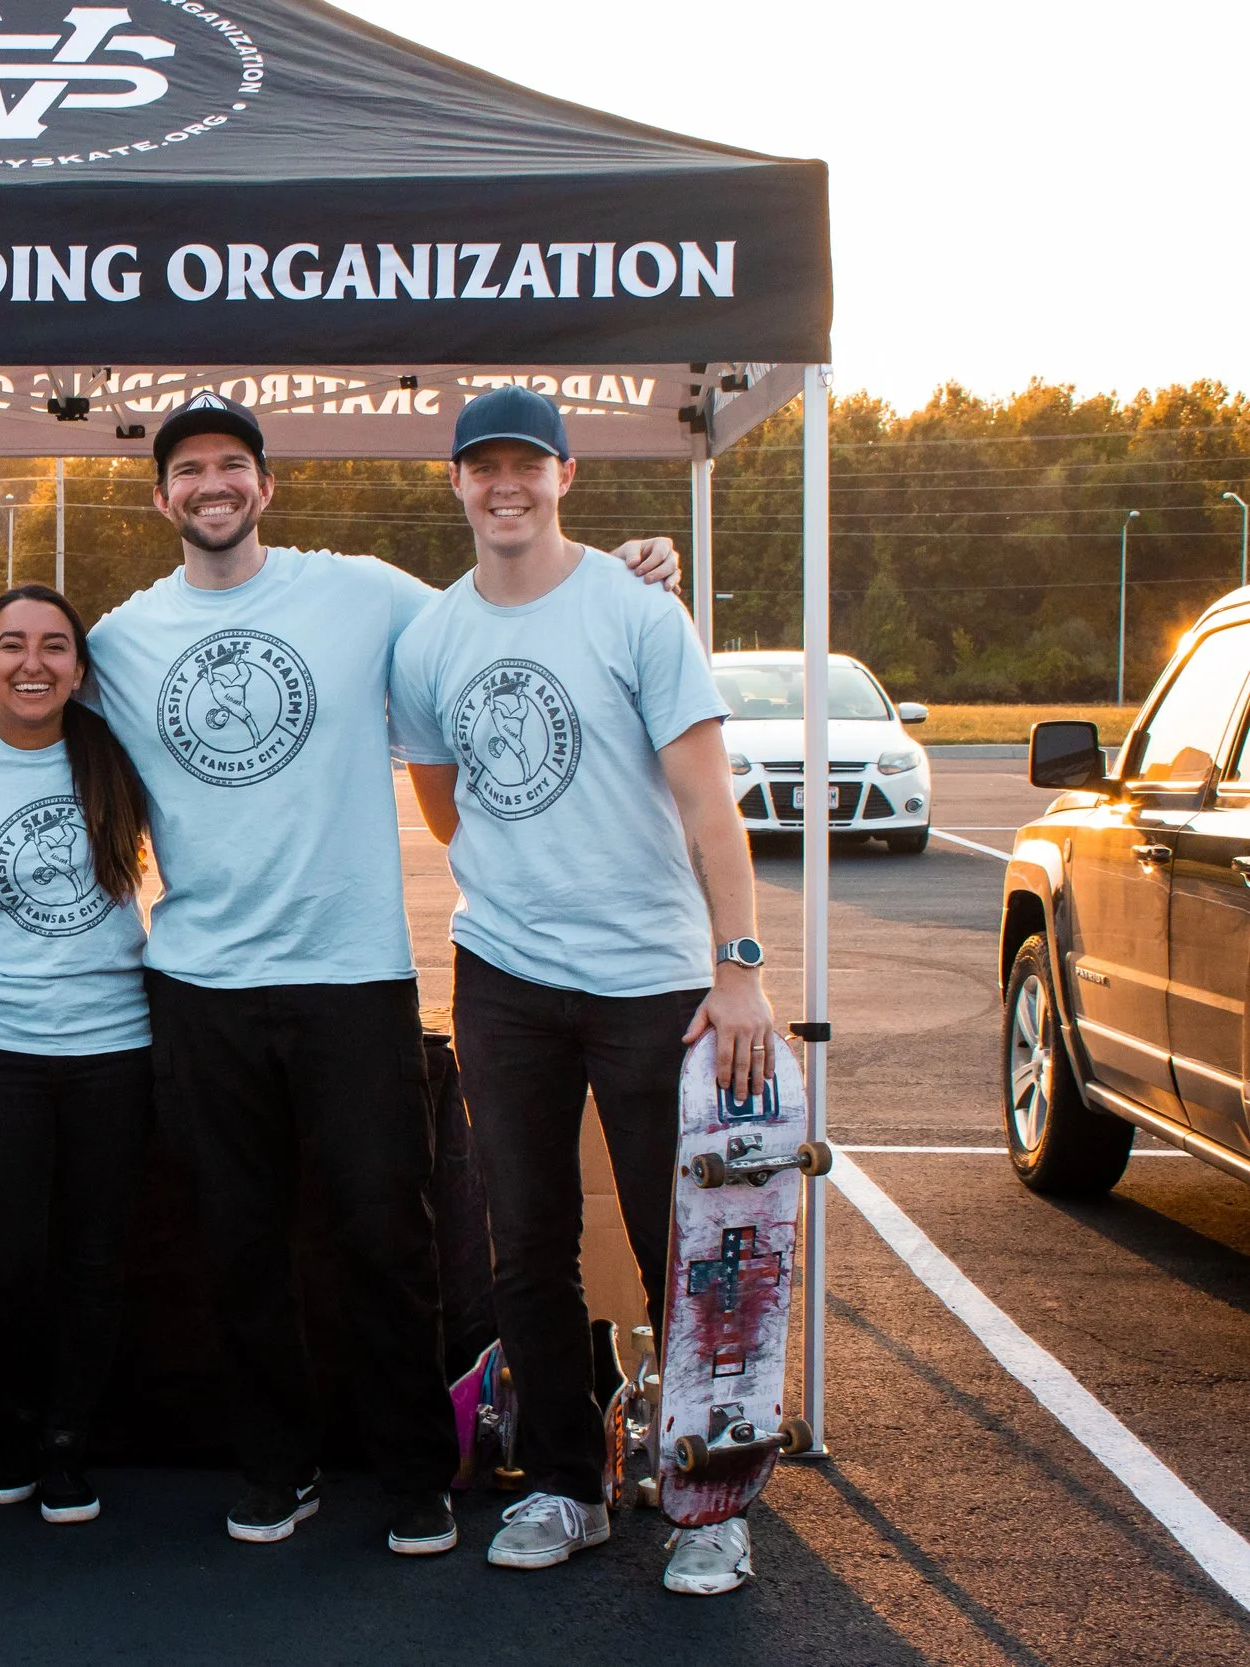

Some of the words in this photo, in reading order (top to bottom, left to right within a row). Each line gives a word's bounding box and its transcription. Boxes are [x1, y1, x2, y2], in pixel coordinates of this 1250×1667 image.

[161, 0, 265, 94] GANIZATION
[166, 239, 737, 302] ORGANIZATION
[168, 672, 193, 753] VARSITY
[194, 641, 252, 666] SKATE
[260, 648, 303, 728] ACADEMY
[482, 671, 532, 692] SKATE
[535, 684, 568, 769] ACADEMY
[199, 754, 255, 773] KANSAS
[257, 736, 286, 764] CITY
[483, 780, 523, 806] KANSAS
[525, 776, 551, 802] CITY
[21, 807, 77, 832] SKATE
[25, 905, 76, 925] KANSAS
[79, 892, 105, 918] CITY
[1074, 966, 1106, 985] PATRIOT
